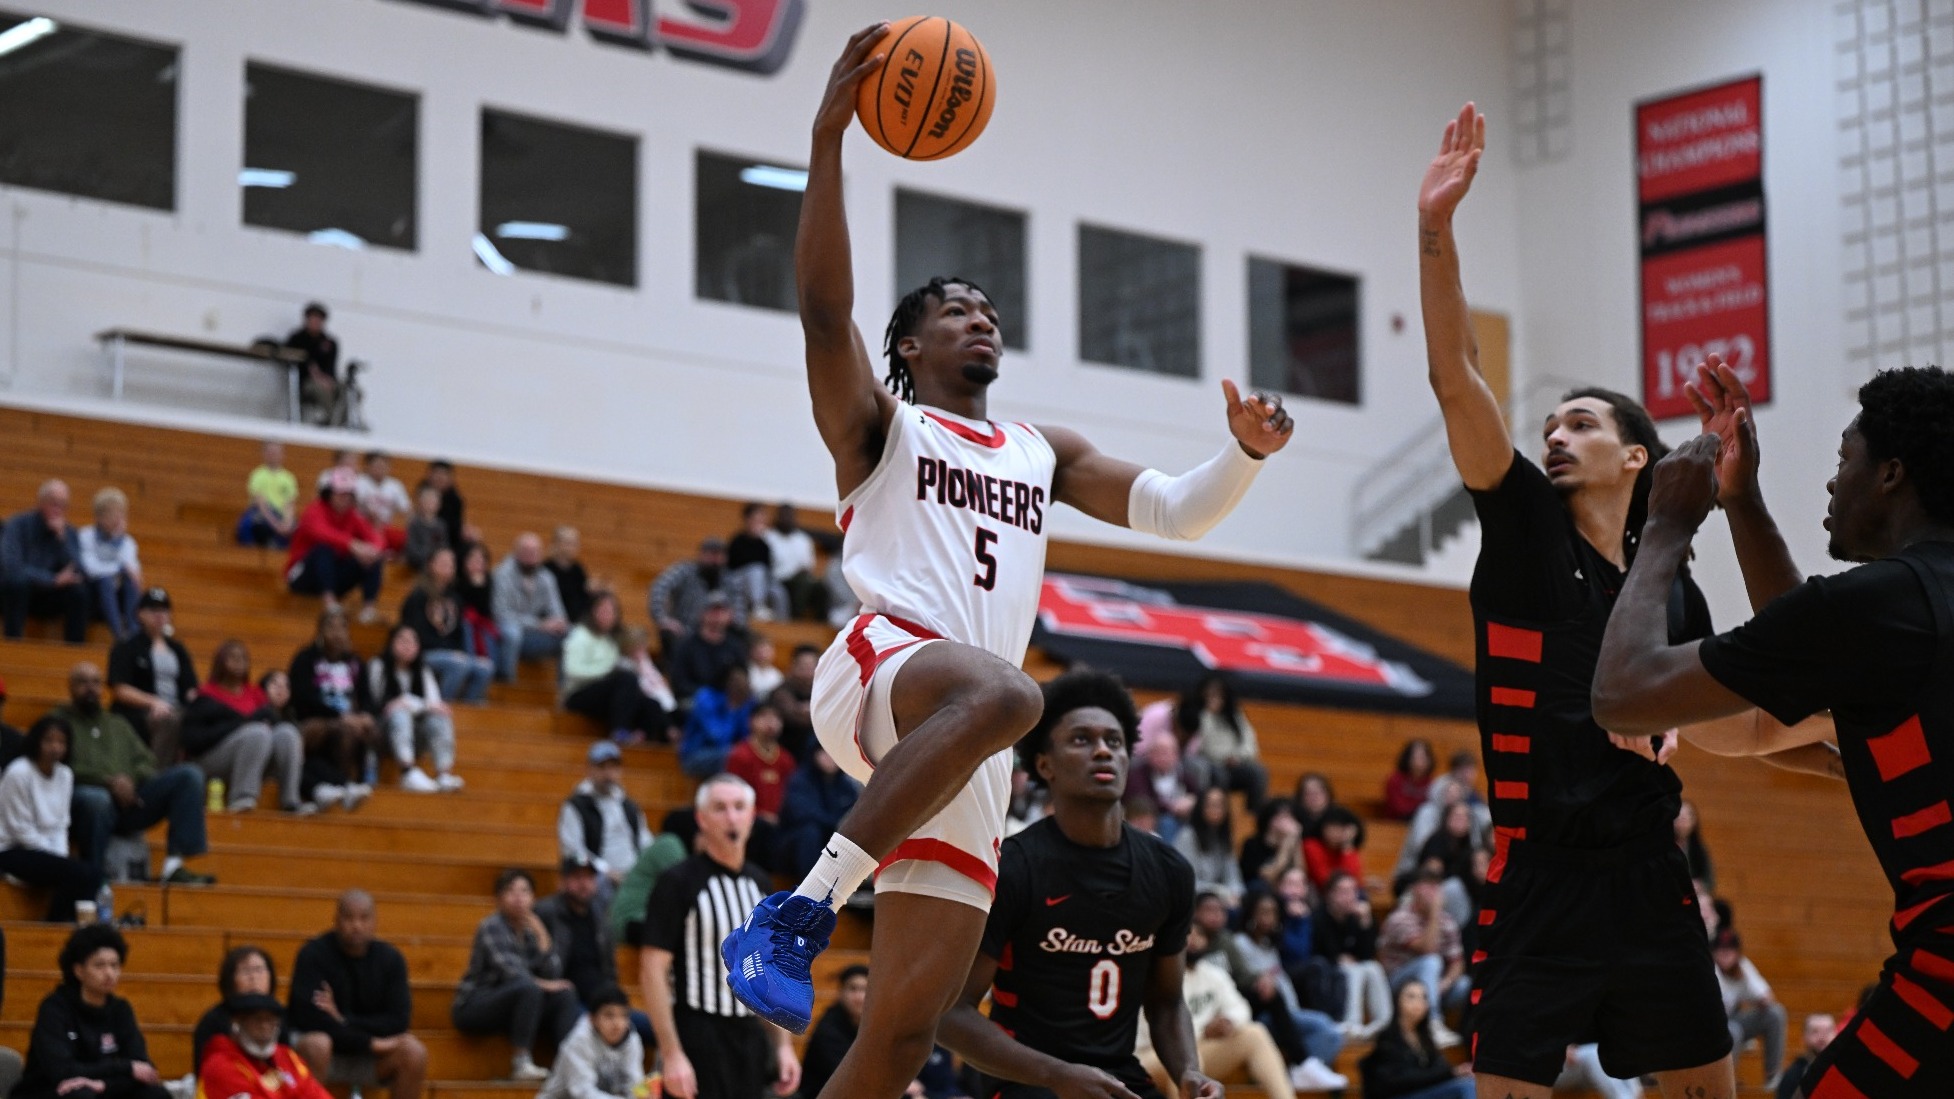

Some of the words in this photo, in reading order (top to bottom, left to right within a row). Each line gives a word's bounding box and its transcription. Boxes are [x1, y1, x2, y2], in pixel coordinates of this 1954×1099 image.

[894, 48, 924, 109] EVO
[928, 47, 976, 139] Wilson
[917, 455, 1045, 535] PIONEERS
[973, 526, 998, 592] 5
[1039, 927, 1102, 954] Stan
[1088, 959, 1121, 1020] 0
